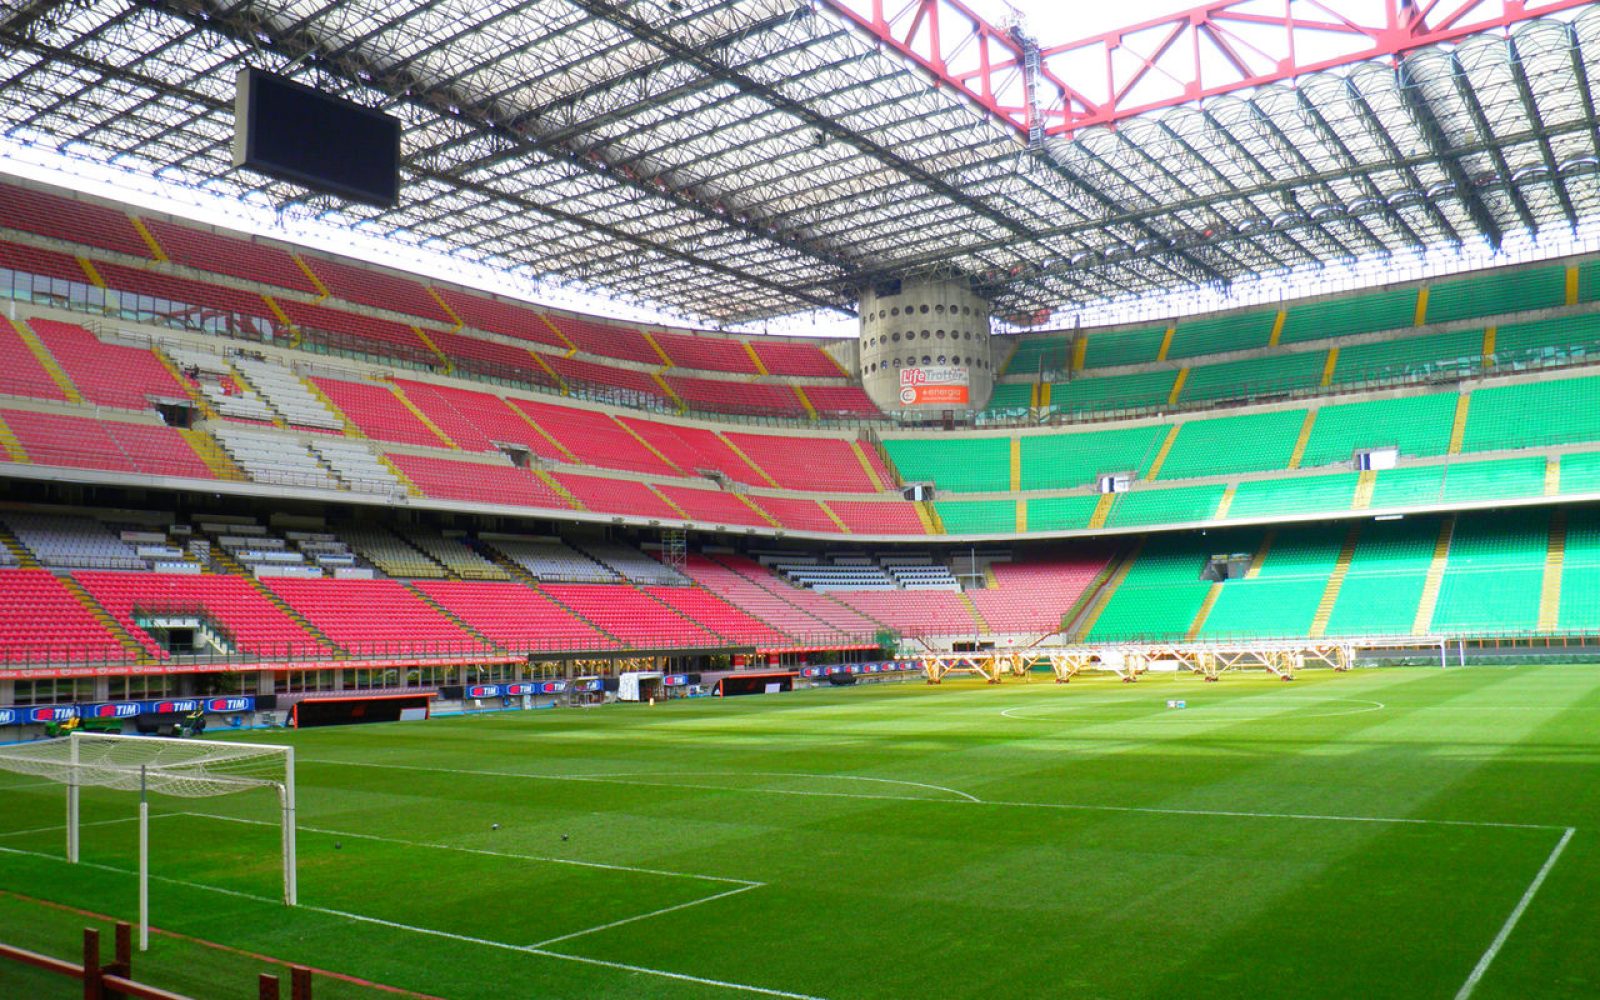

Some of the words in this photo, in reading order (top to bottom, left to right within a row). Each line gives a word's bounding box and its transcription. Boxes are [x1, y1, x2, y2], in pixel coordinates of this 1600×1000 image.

[174, 702, 193, 712] TIM
[227, 699, 245, 709] TIM
[54, 708, 75, 719] TIM
[116, 705, 136, 716] TIM
